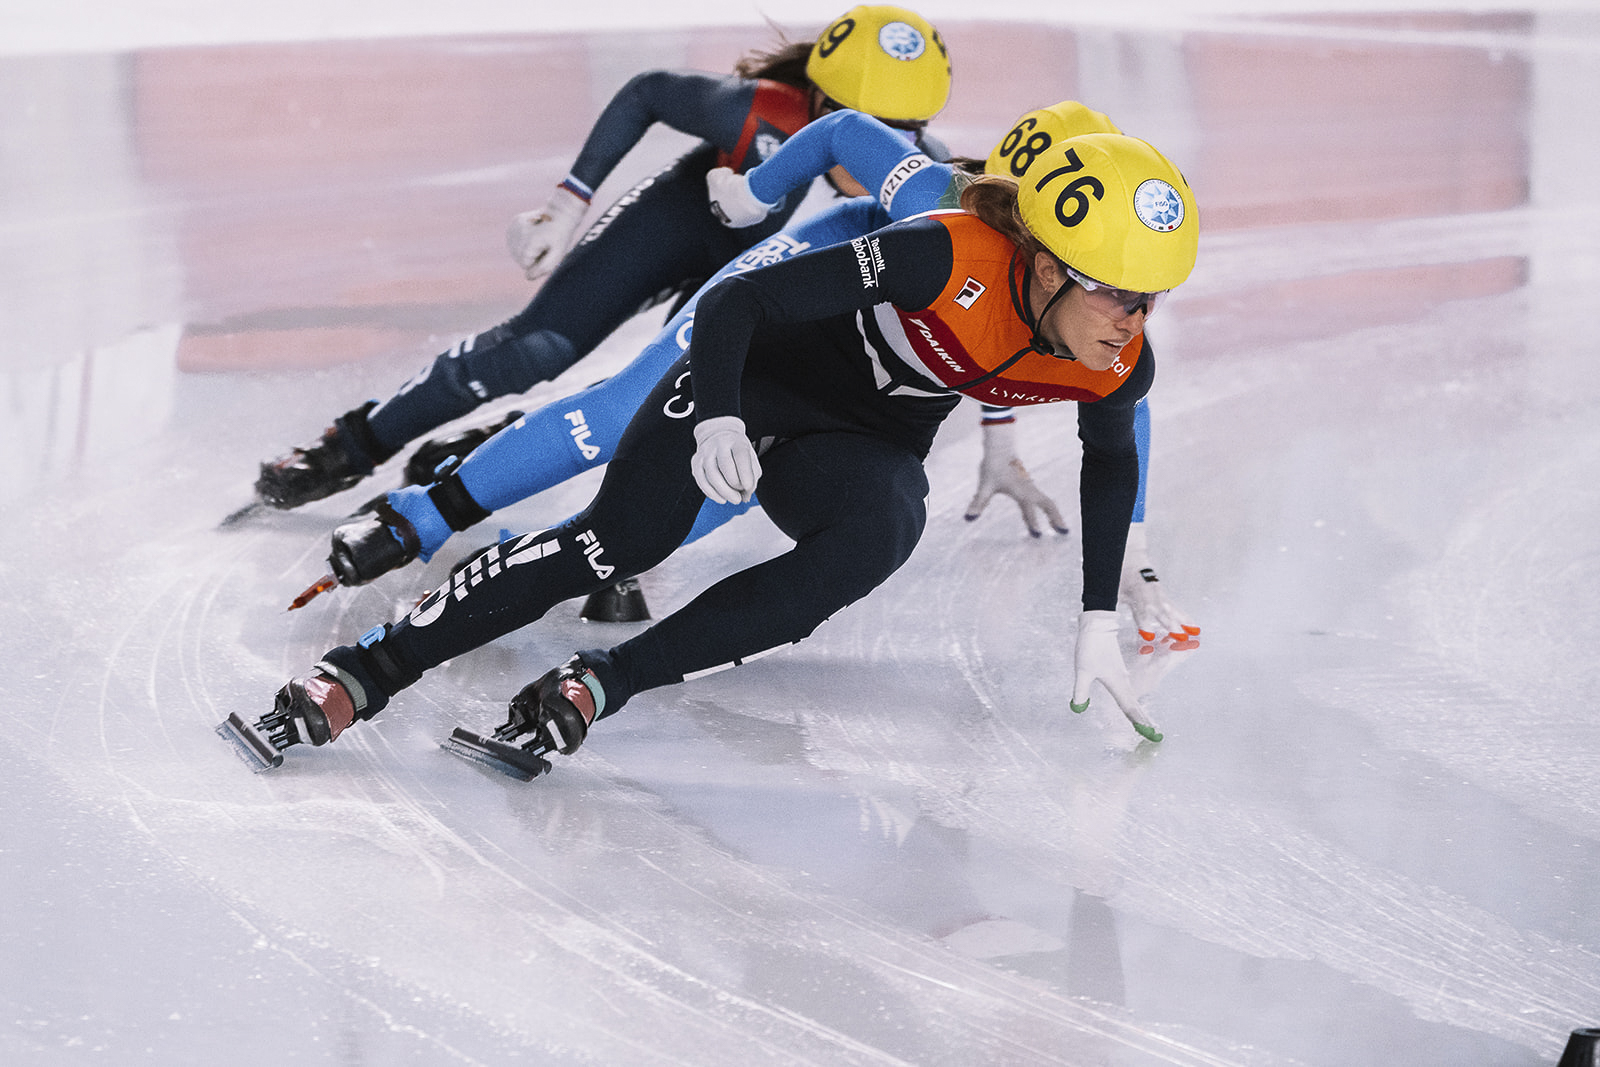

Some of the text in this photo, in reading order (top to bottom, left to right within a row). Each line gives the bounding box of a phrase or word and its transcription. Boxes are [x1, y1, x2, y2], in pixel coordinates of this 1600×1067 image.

[999, 117, 1052, 178] 68
[1034, 147, 1105, 228] 76
[871, 237, 886, 273] TeamNL
[919, 329, 966, 373] DAIKIN
[563, 409, 601, 461] FILA
[575, 529, 615, 580] FILA
